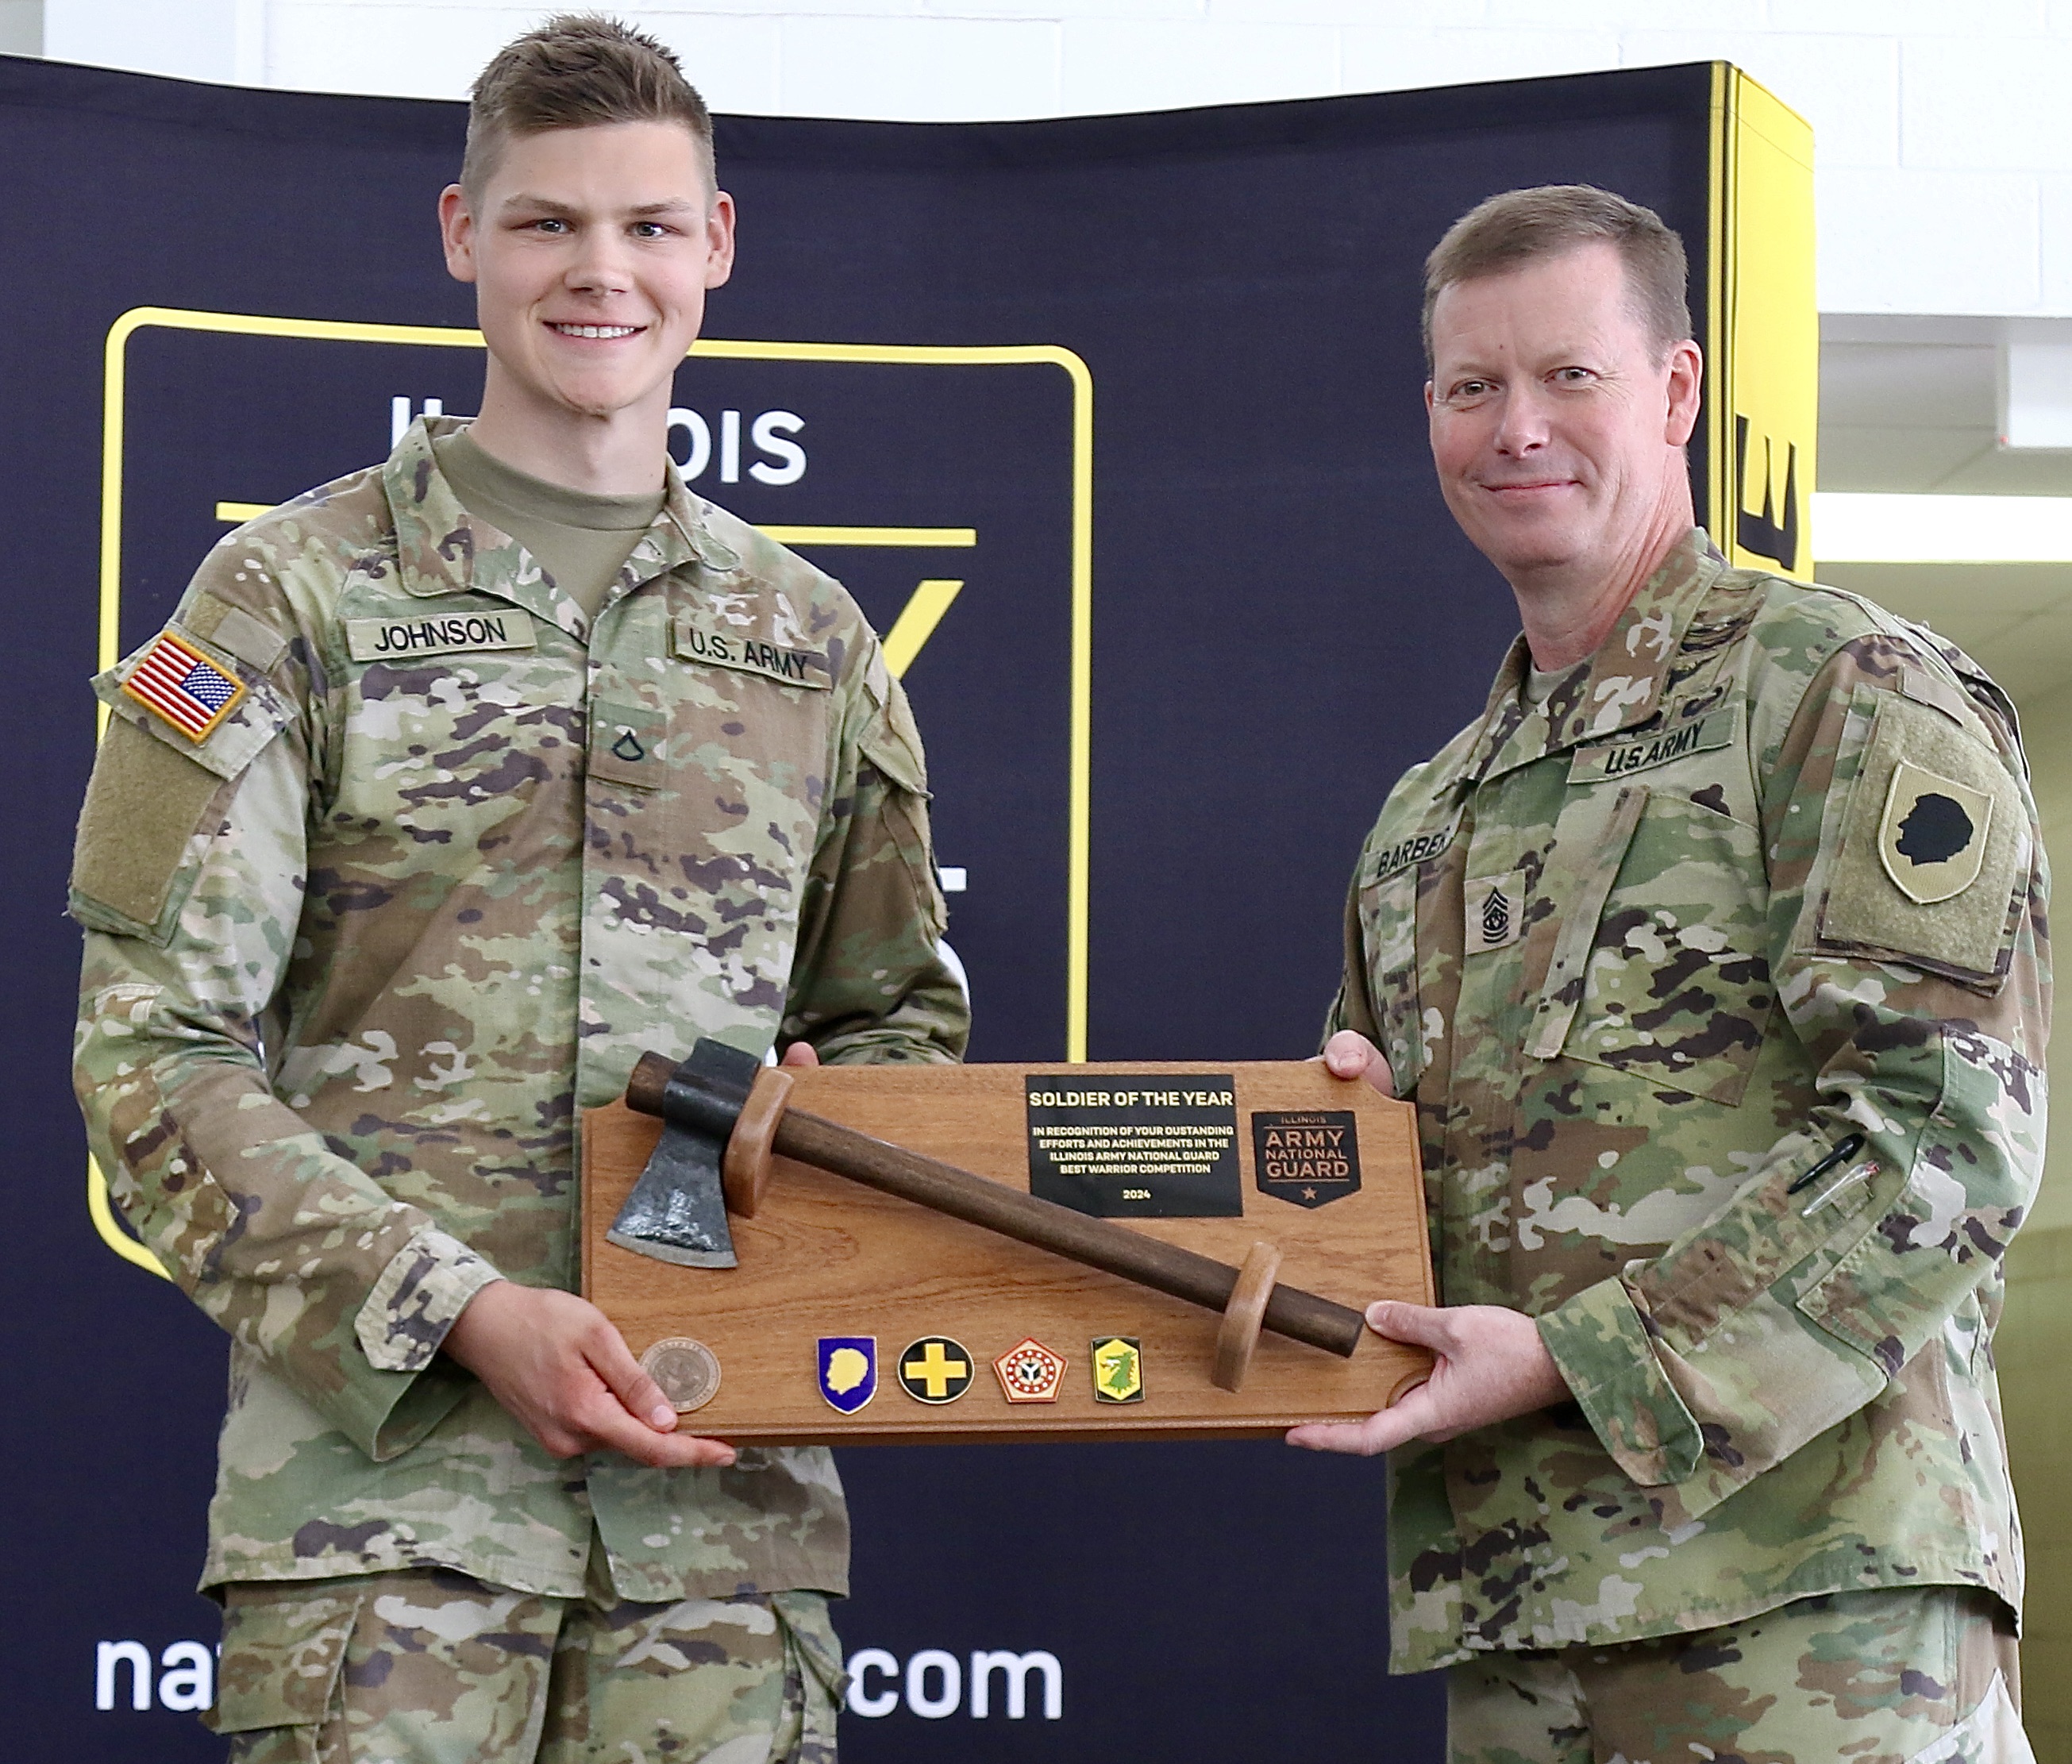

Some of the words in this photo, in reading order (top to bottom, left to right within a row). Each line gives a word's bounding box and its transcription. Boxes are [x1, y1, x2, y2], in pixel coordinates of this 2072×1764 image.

[375, 617, 507, 652] JOHNSON
[689, 628, 736, 661] U.S.
[744, 640, 807, 679] ARMY
[1641, 718, 1705, 766] ARMY
[1030, 1091, 1111, 1107] SOLDIER
[1114, 1091, 1139, 1107] OF
[1142, 1091, 1180, 1107] THE
[1182, 1091, 1234, 1107] YEAR
[1033, 1127, 1045, 1136] IN
[1046, 1127, 1118, 1136] RECOGNITION
[1119, 1127, 1134, 1136] OF
[1134, 1127, 1164, 1136] YOUR
[1165, 1126, 1234, 1136] OUSTANDING
[1039, 1139, 1085, 1149] EFFORTS
[1087, 1139, 1110, 1149] AND
[1111, 1139, 1192, 1149] ACHIEVEMENTS
[1195, 1139, 1207, 1148] IN
[1207, 1138, 1229, 1148] THE
[1265, 1130, 1343, 1147] ARMY
[1049, 1151, 1094, 1161] ILLINOIS
[1096, 1151, 1127, 1161] ARMY
[1127, 1151, 1181, 1161] NATIONAL
[1184, 1151, 1219, 1161] GUARD
[1265, 1148, 1347, 1160] NATIONAL
[1060, 1165, 1087, 1174] BEST
[1088, 1165, 1138, 1174] WARRIOR
[1139, 1165, 1211, 1173] COMPETITION
[1266, 1161, 1349, 1177] GUARD
[1123, 1189, 1151, 1200] 2024
